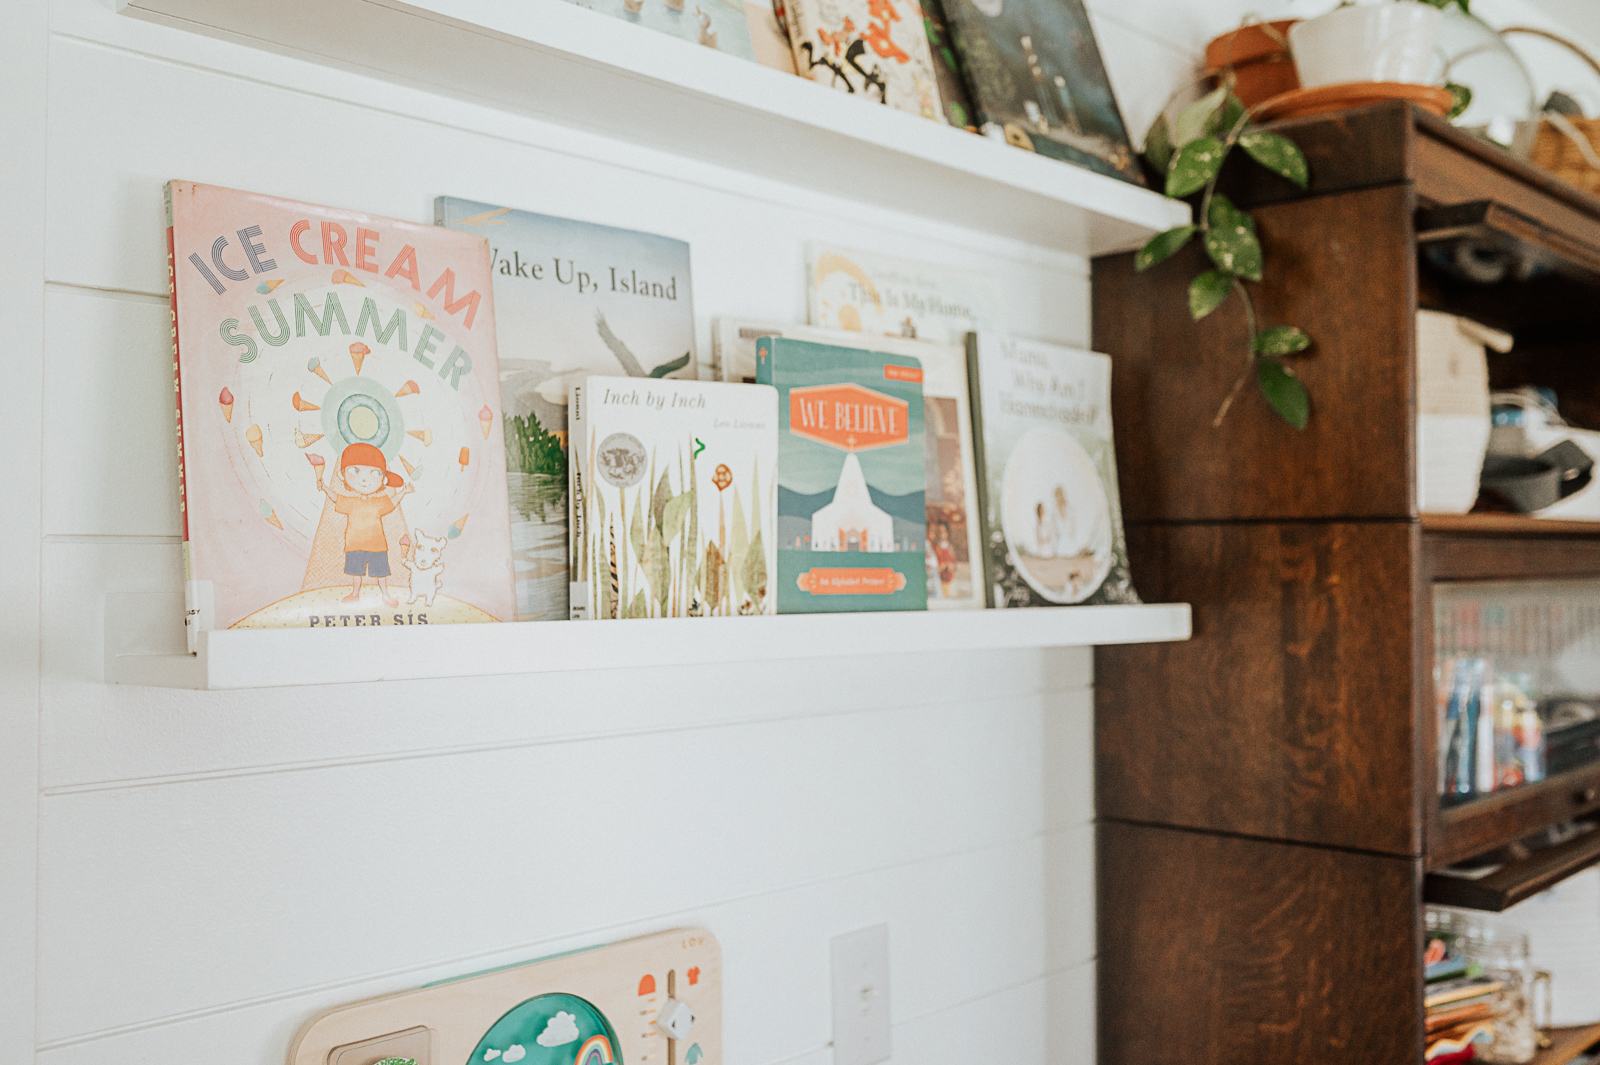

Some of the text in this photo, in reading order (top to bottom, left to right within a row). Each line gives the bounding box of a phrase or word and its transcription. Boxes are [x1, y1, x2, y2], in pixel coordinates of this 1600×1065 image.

[188, 219, 482, 330] ICE CREAM
[553, 257, 599, 294] Up,
[608, 266, 678, 301] Island
[219, 291, 473, 392] SUMMER
[603, 388, 707, 411] Inch by Inch
[800, 397, 900, 435] WE BELIEVE
[308, 609, 429, 628] PETER SÍS
